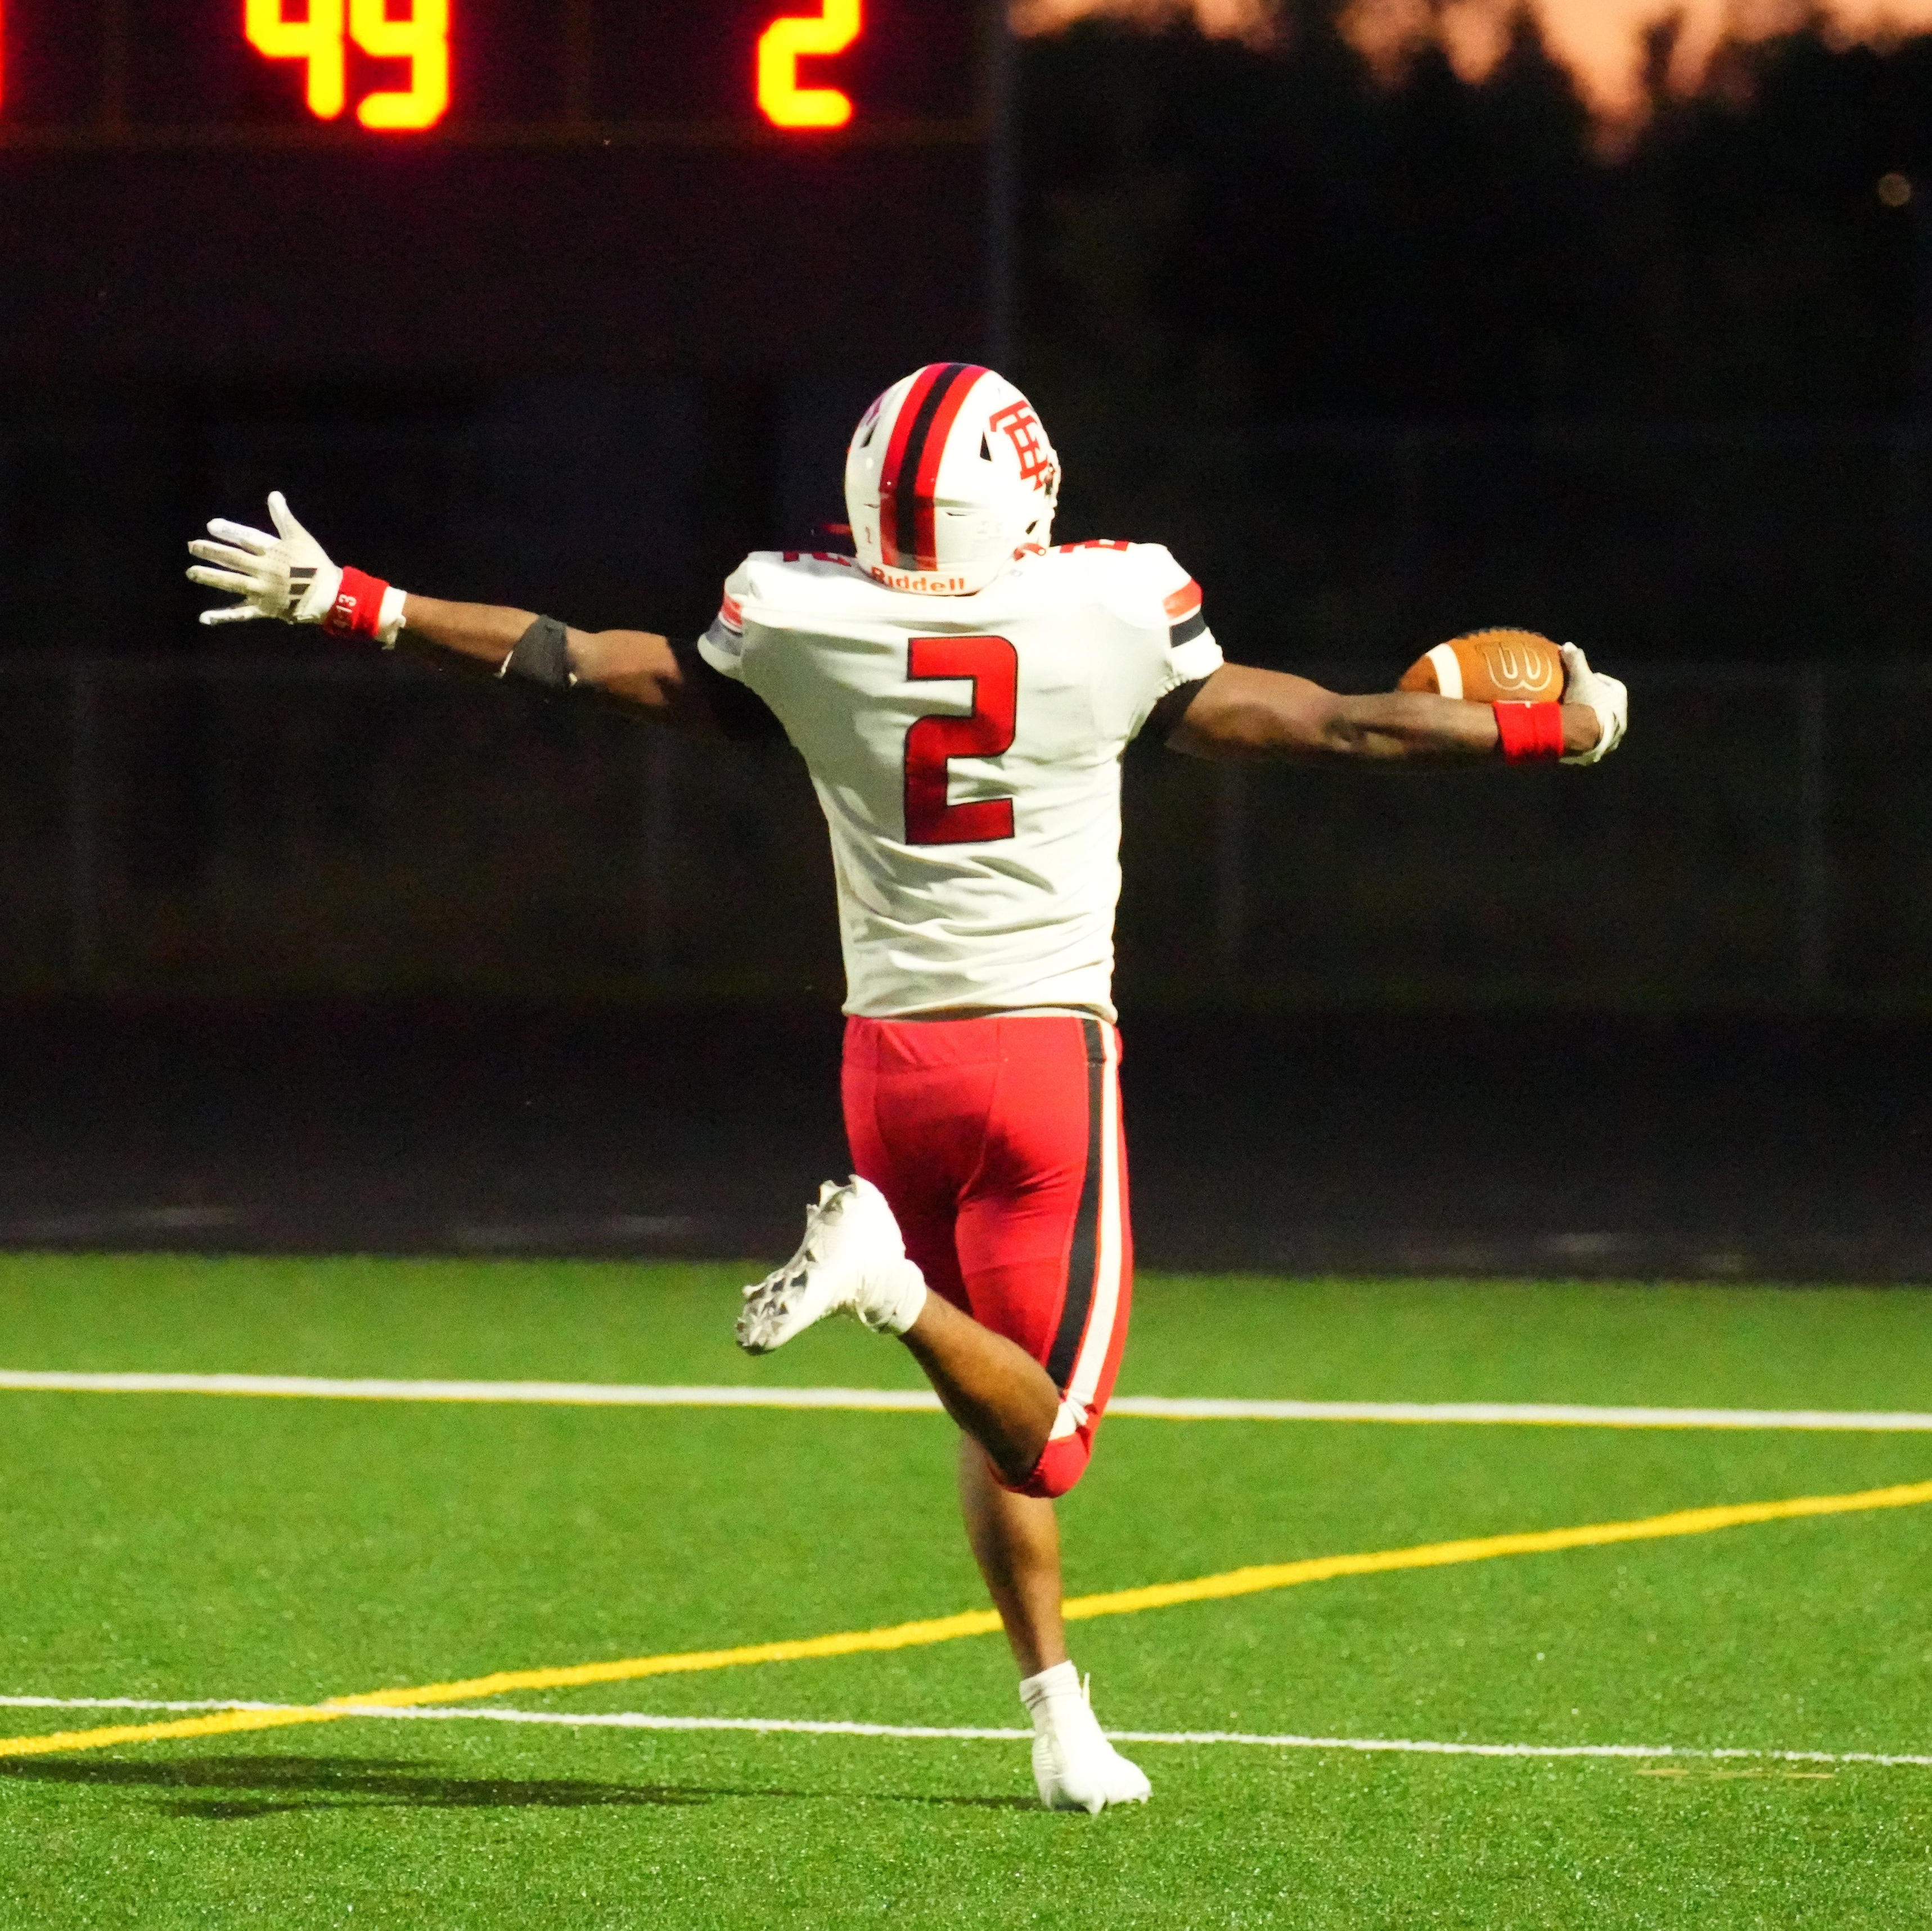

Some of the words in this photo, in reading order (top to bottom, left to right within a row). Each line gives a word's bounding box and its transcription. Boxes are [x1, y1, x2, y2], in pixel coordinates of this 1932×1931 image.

[244, 0, 449, 129] 49
[757, 0, 861, 127] 2
[871, 566, 965, 592] Riddell
[905, 635, 1017, 845] 2
